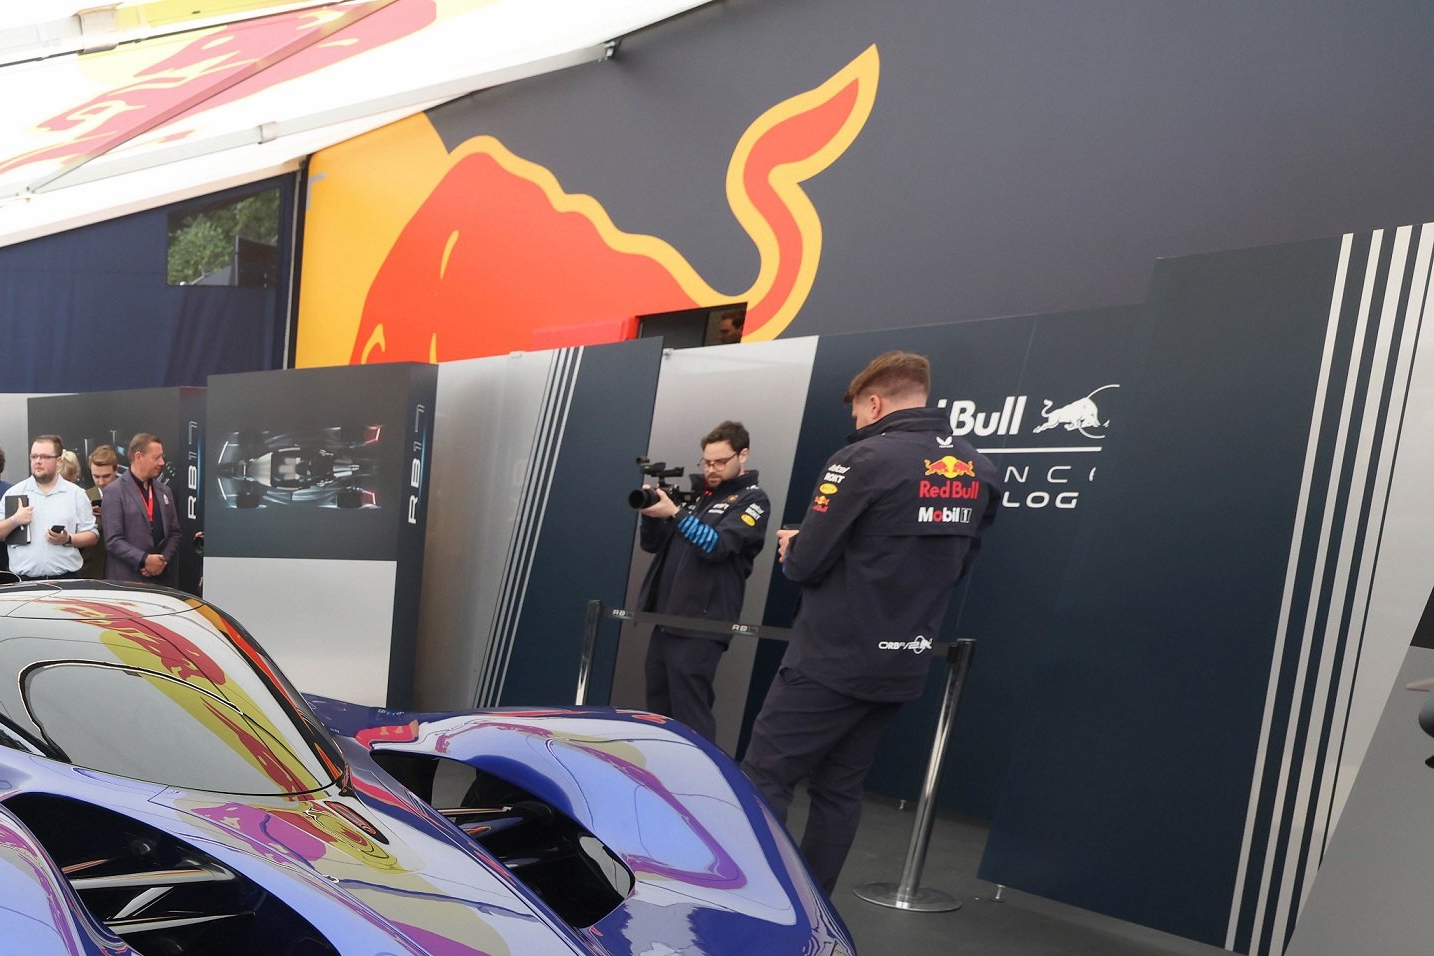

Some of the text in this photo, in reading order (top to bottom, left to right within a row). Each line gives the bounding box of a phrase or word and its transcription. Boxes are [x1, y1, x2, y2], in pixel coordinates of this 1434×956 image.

[950, 396, 1027, 437] Bull
[187, 420, 198, 520] RB17
[408, 403, 426, 525] RB17
[918, 480, 980, 500] Red Bull
[1002, 491, 1080, 509] LOG
[917, 506, 961, 523] Mobil
